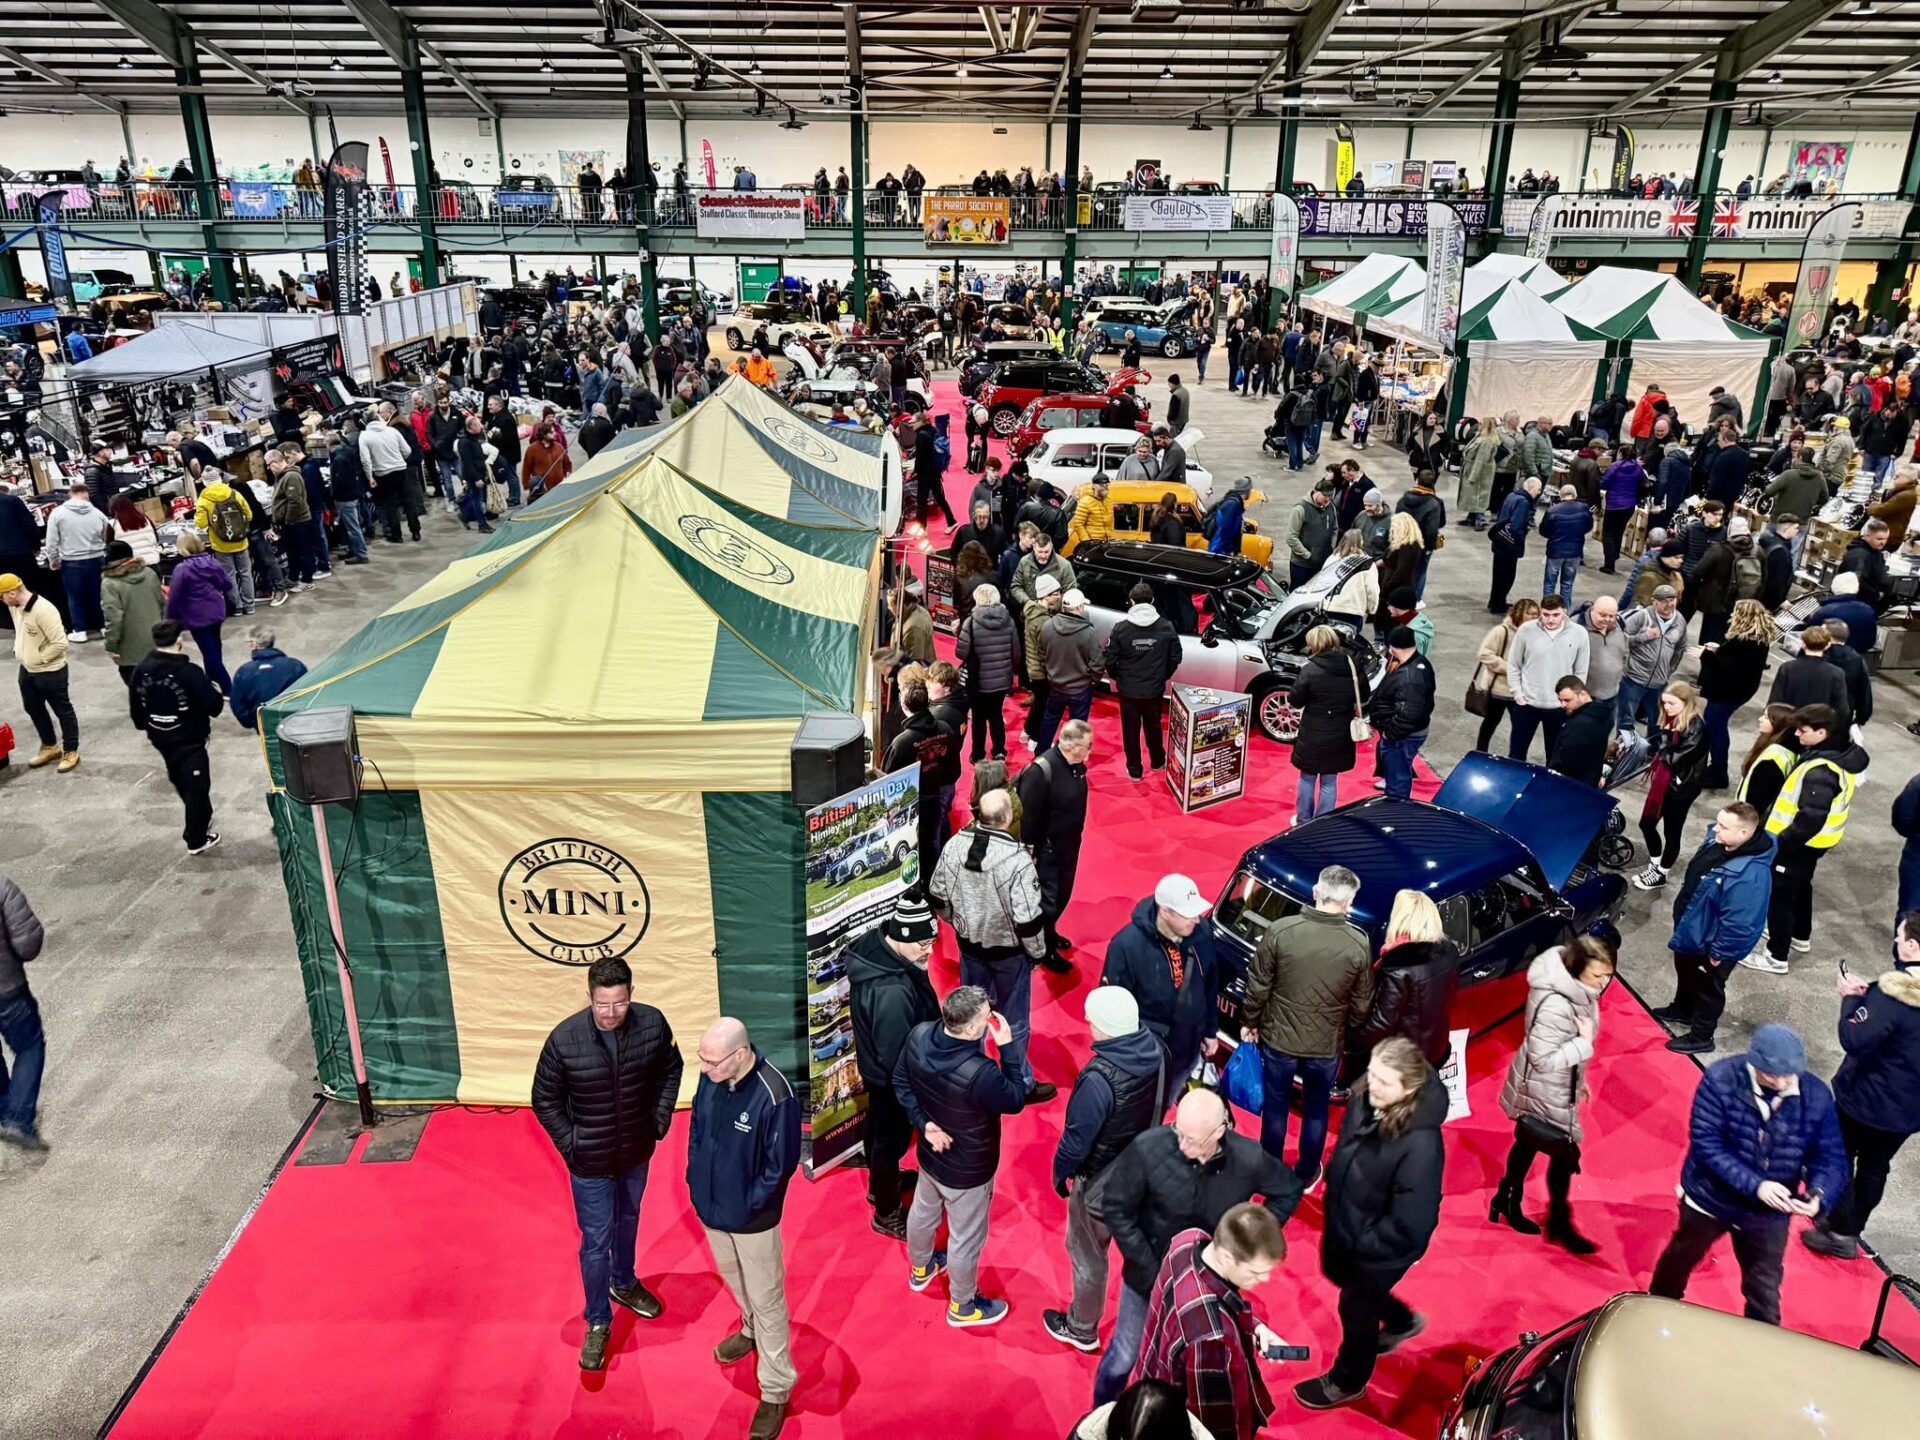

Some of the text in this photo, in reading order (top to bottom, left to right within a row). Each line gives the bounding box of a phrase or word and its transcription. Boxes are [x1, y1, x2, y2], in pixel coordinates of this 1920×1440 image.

[700, 209, 801, 221] Stafford Classic Motorcycle Show
[931, 200, 1004, 211] THE PARROT SOCIETY UK
[1157, 200, 1202, 217] Bayley's
[1315, 201, 1330, 232] TASTY
[1329, 202, 1404, 234] MEALS
[335, 187, 350, 314] HUDDERSFIELD SPARES
[809, 778, 910, 832] British Mini Day
[810, 814, 857, 843] Himley Hall
[518, 843, 623, 872] BRITISH
[521, 888, 627, 916] MINI
[550, 944, 614, 962] CLUB
